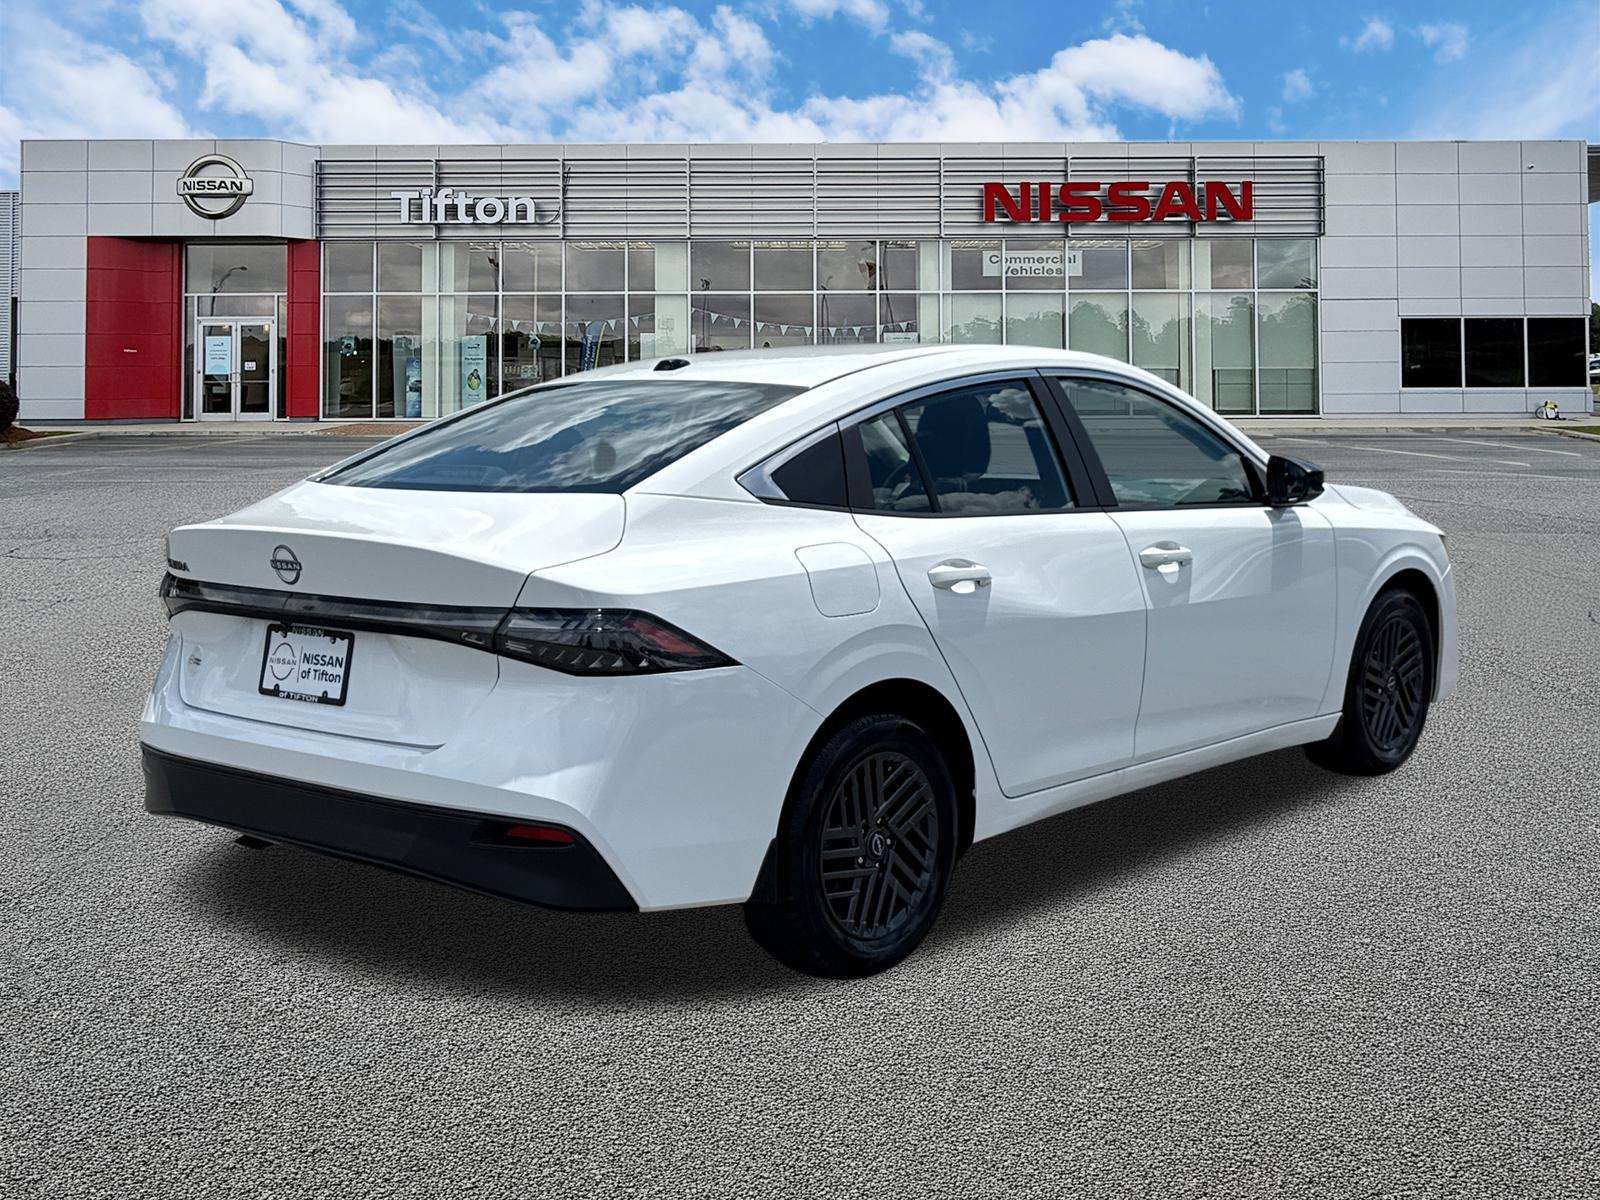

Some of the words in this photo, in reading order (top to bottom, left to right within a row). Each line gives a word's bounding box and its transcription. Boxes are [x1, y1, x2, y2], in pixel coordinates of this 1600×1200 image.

[182, 180, 243, 191] NISSAN
[391, 187, 536, 224] Tifton
[984, 181, 1253, 222] NISSAN
[988, 254, 1077, 265] Cmmercil
[292, 626, 325, 638] NISSAN
[269, 656, 297, 666] NISSAN
[302, 652, 344, 669] NISSAN
[301, 667, 311, 680] of
[313, 669, 341, 683] Tifton
[289, 692, 319, 703] TIFTON
